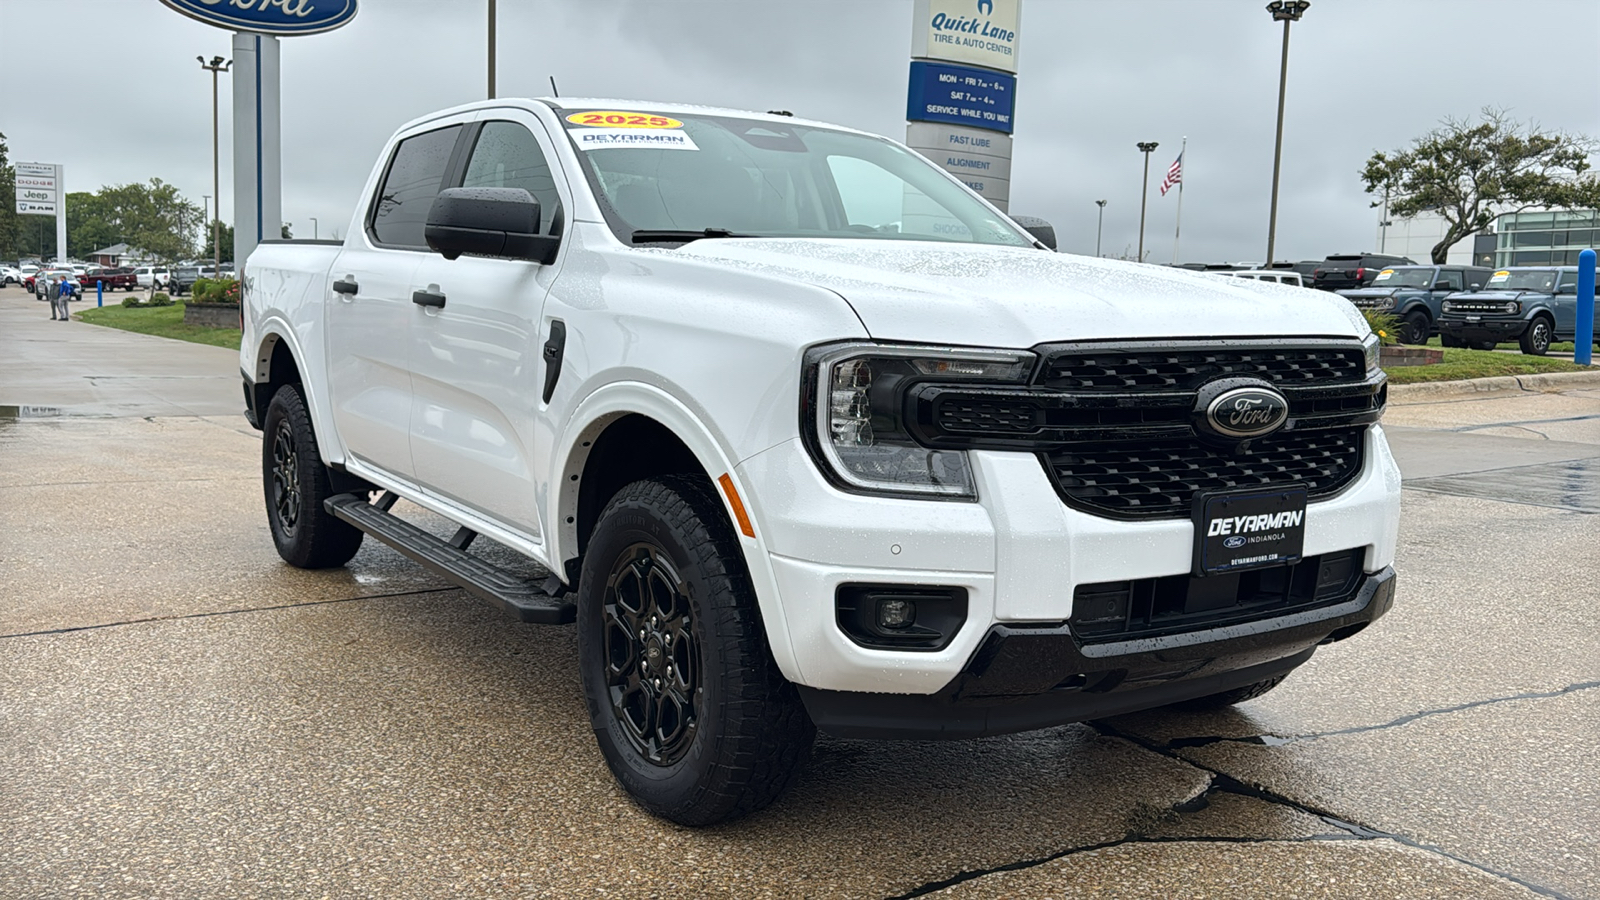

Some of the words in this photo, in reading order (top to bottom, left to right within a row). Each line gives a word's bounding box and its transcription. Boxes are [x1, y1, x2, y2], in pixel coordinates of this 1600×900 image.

[931, 12, 981, 34] Quick
[980, 21, 1015, 42] Lane
[933, 33, 954, 44] TIRE
[954, 36, 961, 45] &
[962, 38, 985, 49] AUTO
[985, 42, 1013, 56] CENTER
[938, 73, 958, 84] MON
[965, 77, 976, 86] FRI
[950, 91, 964, 100] SAT
[582, 114, 669, 126] 2025
[926, 104, 959, 116] SERVICE
[960, 108, 982, 119] WHILE
[982, 111, 996, 121] YOU
[996, 113, 1010, 123] WAIT
[582, 134, 684, 142] DEYARMAN
[949, 134, 970, 145] FAST
[971, 137, 991, 148] LUBE
[946, 157, 991, 170] ALIGNMENT
[24, 190, 48, 200] Jeep
[1230, 398, 1273, 425] Ford
[1207, 510, 1303, 537] DEYARMAN
[1247, 533, 1286, 544] INDIANOLA
[1231, 554, 1278, 566] DEYARMANFORD.COM
